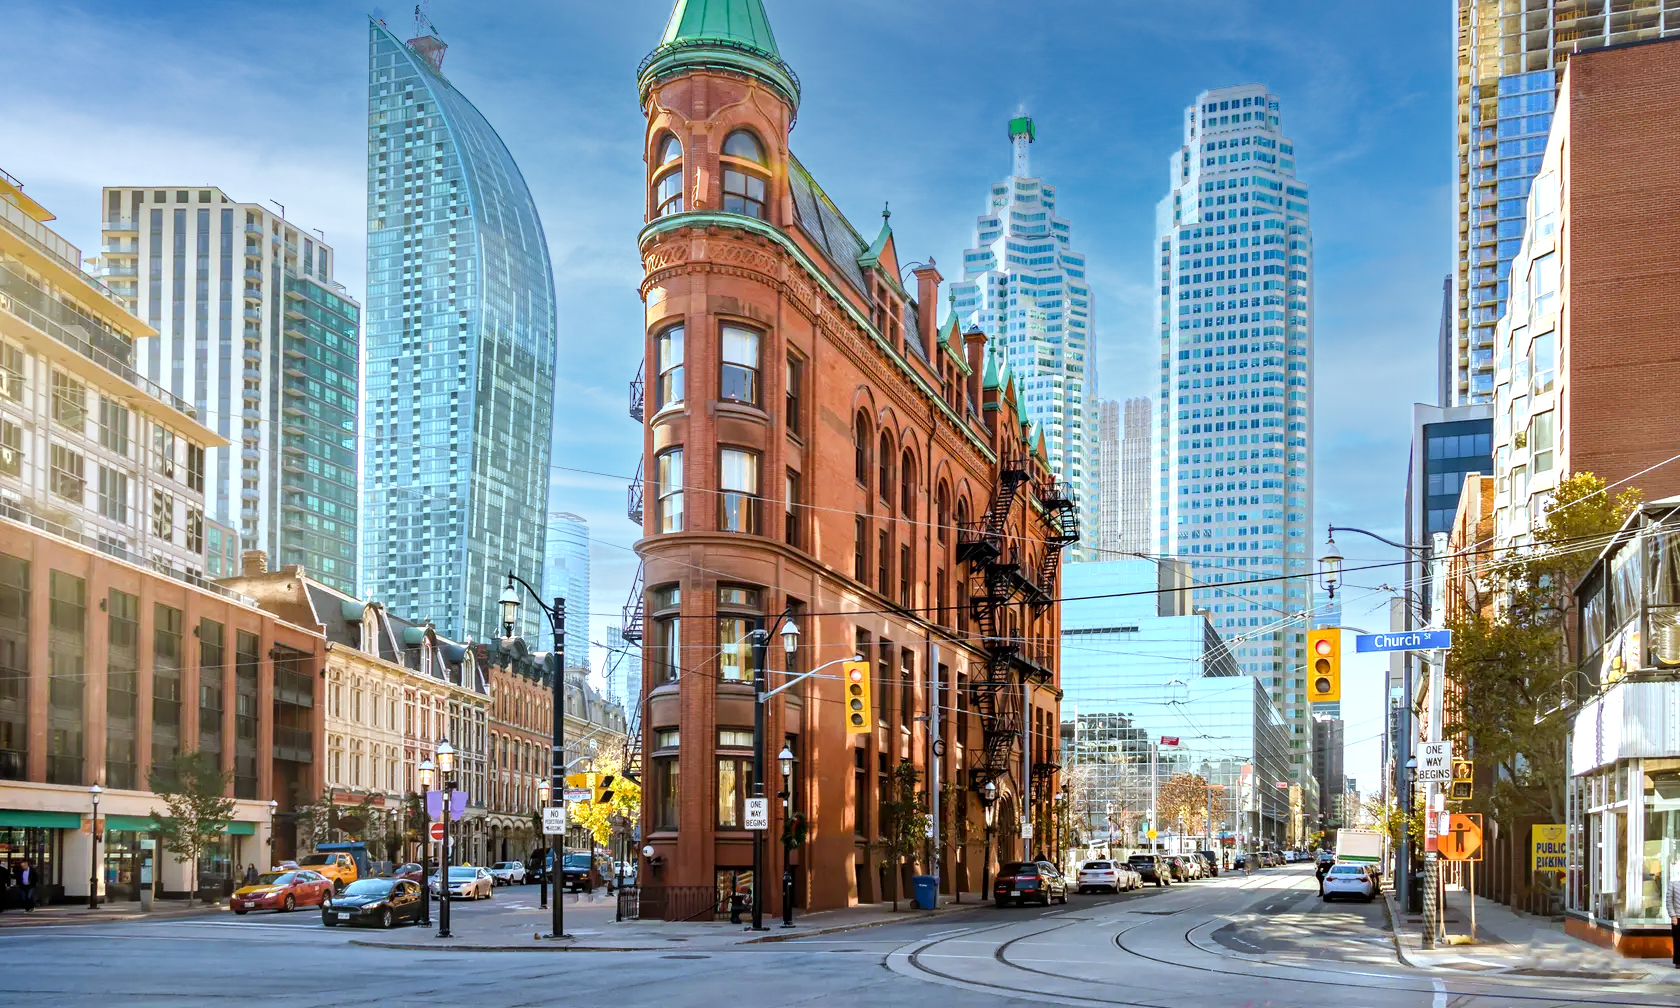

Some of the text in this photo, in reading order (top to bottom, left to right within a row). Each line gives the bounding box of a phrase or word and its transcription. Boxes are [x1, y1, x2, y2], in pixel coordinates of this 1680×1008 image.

[1374, 633, 1420, 648] Church
[1425, 745, 1443, 755] ONE
[1426, 757, 1443, 767] WAY
[1419, 769, 1450, 779] BEGINS
[550, 810, 559, 818] NO
[750, 810, 761, 818] WAY
[1536, 842, 1566, 854] PUBLIC
